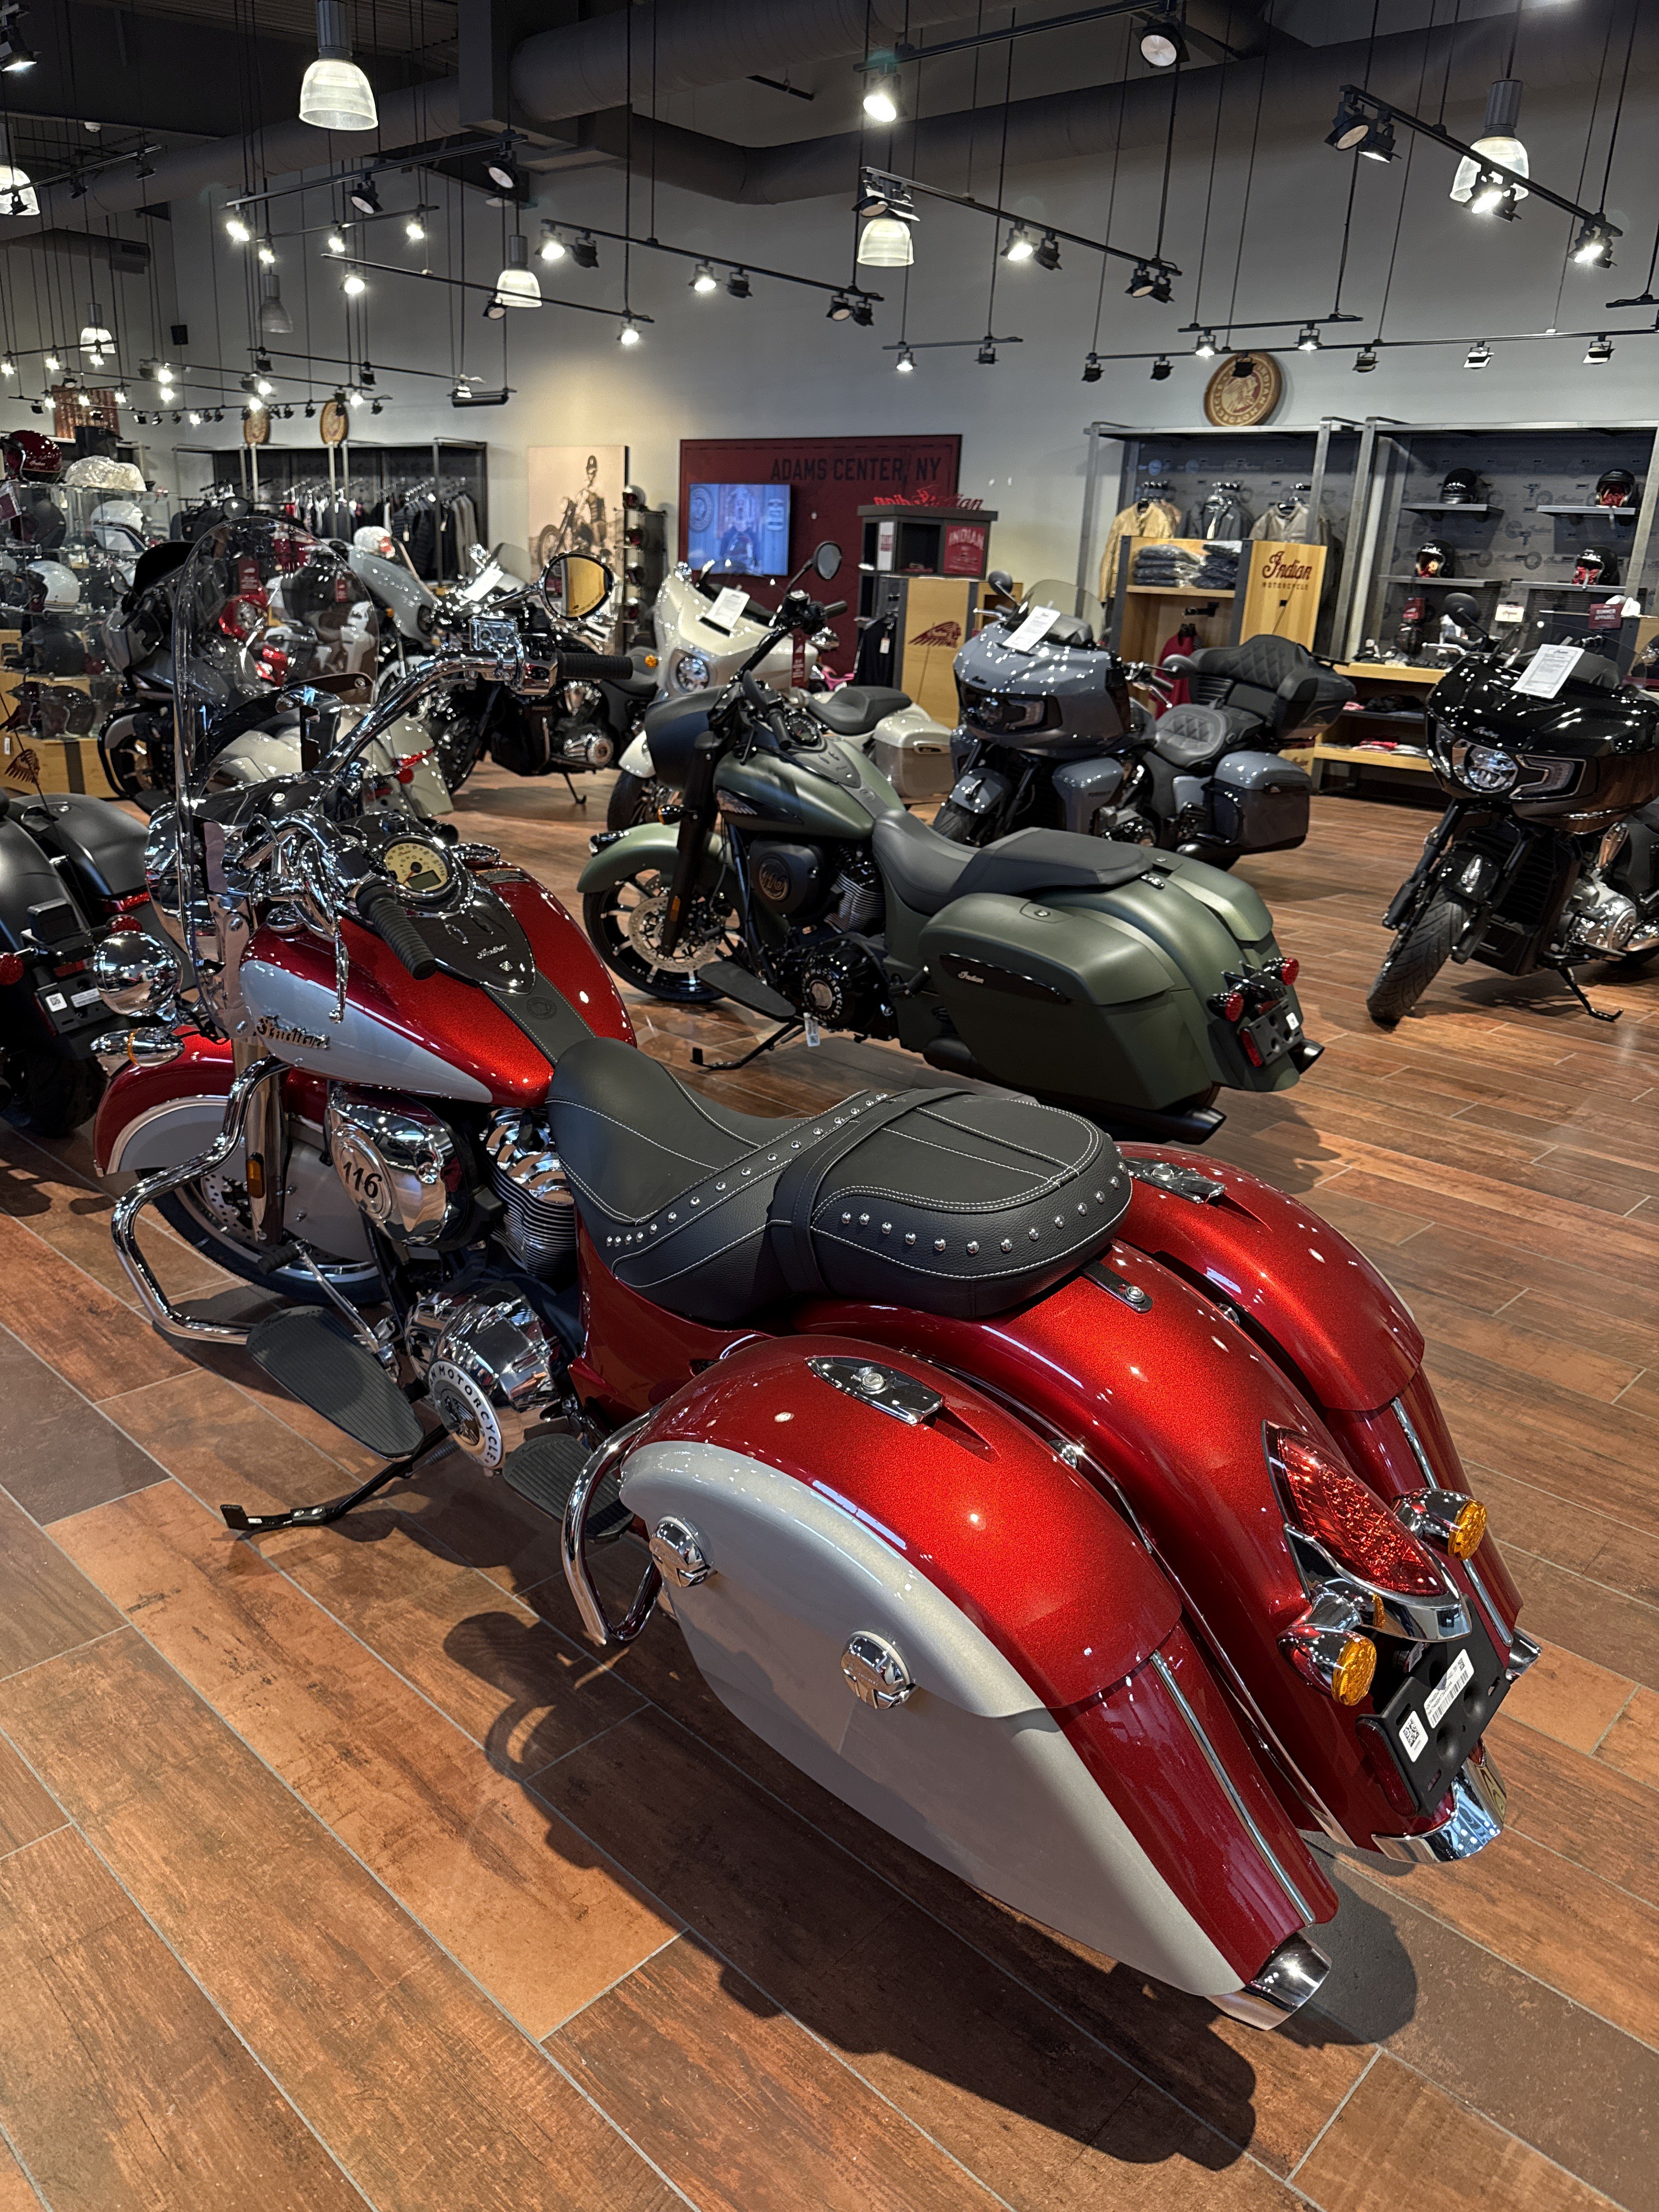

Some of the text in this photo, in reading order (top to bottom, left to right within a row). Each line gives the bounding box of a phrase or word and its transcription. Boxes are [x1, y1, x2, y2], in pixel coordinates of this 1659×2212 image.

[770, 457, 941, 484] ADAMS CENTER, NY
[1262, 551, 1312, 580] Indian
[1262, 582, 1309, 590] MOTORCYCLE
[958, 970, 985, 984] Indian
[343, 1161, 383, 1199] 116
[439, 1364, 498, 1461] MOTORCYCLE
